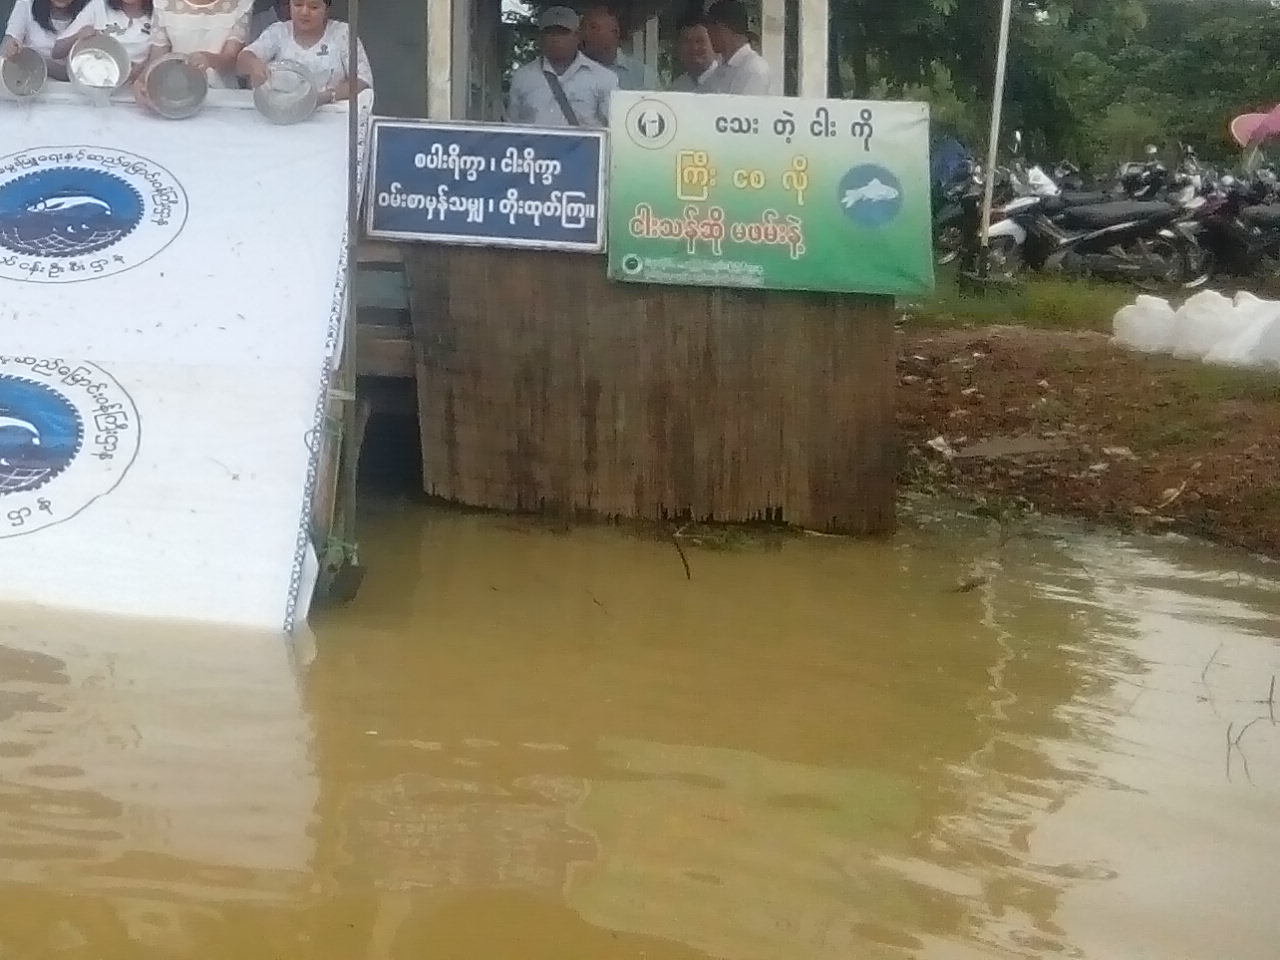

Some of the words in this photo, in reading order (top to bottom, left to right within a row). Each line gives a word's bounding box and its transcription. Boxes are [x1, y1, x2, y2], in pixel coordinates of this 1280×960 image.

[715, 115, 759, 135] သေး
[773, 110, 796, 144] တဲ့
[810, 106, 837, 138] ငါး
[850, 108, 874, 151] ကို
[676, 150, 717, 201] ကြီး
